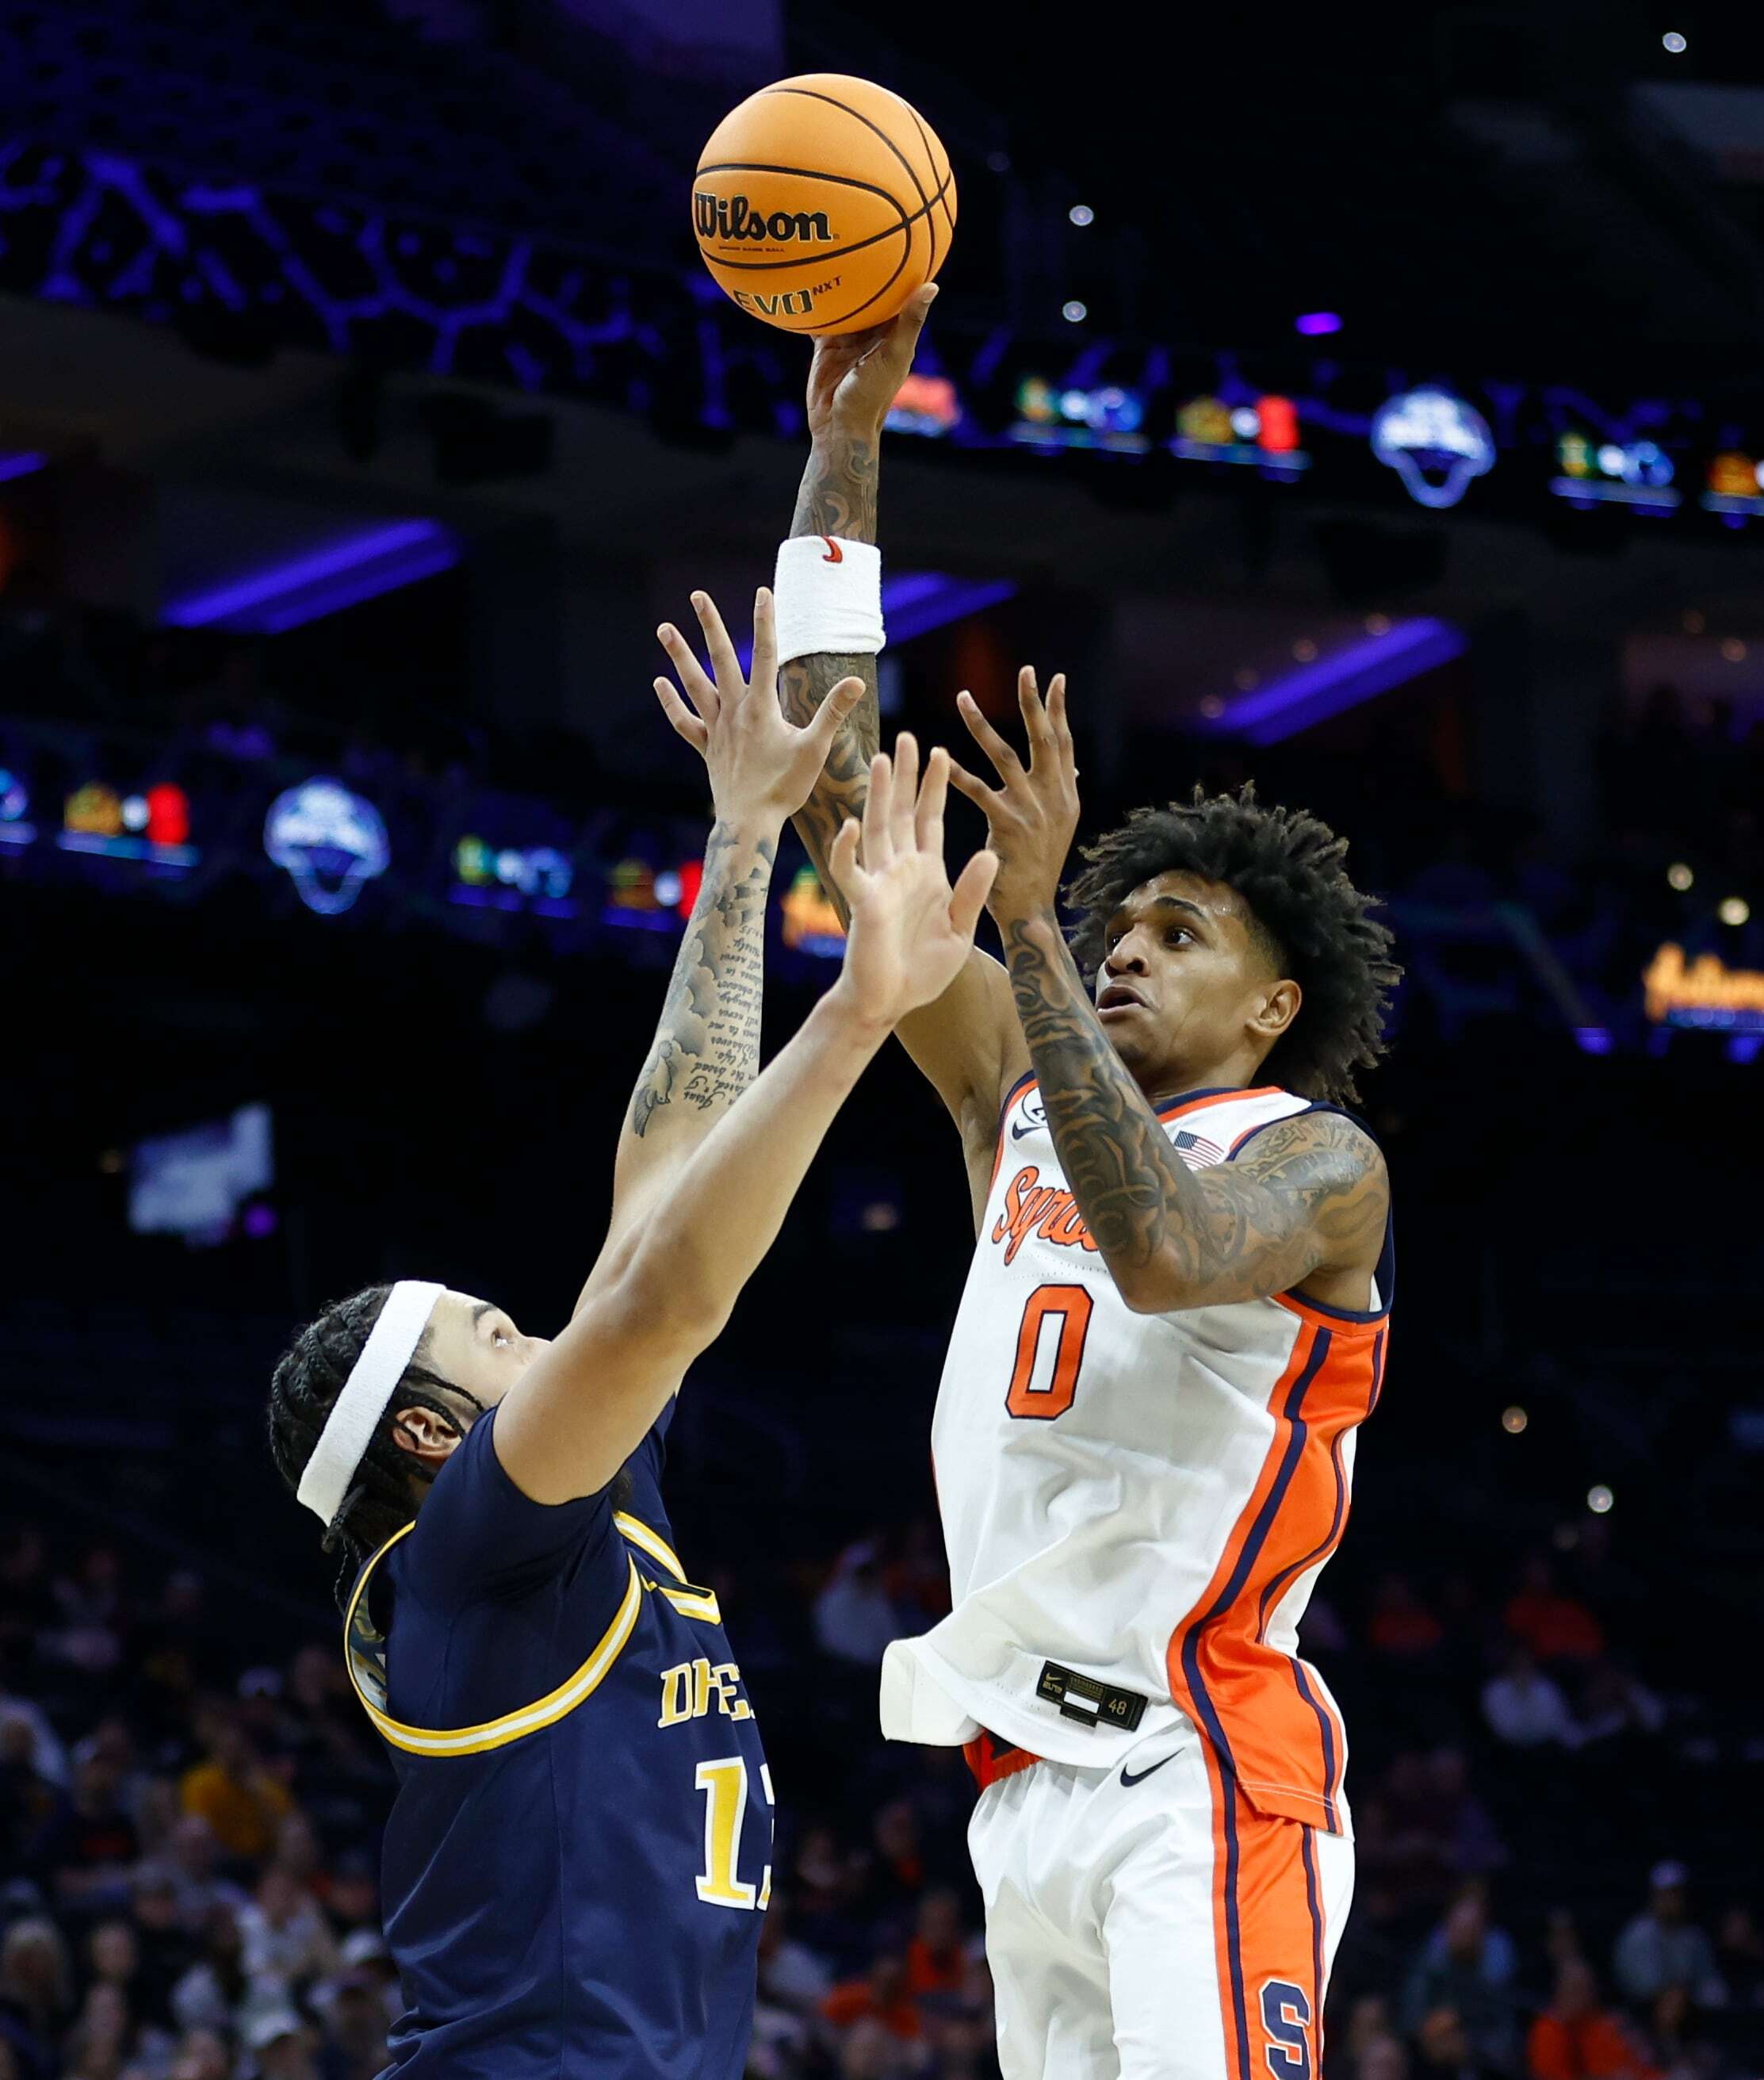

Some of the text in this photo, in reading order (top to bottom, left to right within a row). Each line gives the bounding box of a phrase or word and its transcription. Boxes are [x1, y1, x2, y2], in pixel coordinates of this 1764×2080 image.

[694, 191, 834, 243] Wilson
[812, 275, 841, 296] NXT
[1005, 1284, 1094, 1419] 0
[1108, 1698, 1127, 1716] 48
[1258, 1978, 1311, 2080] S
